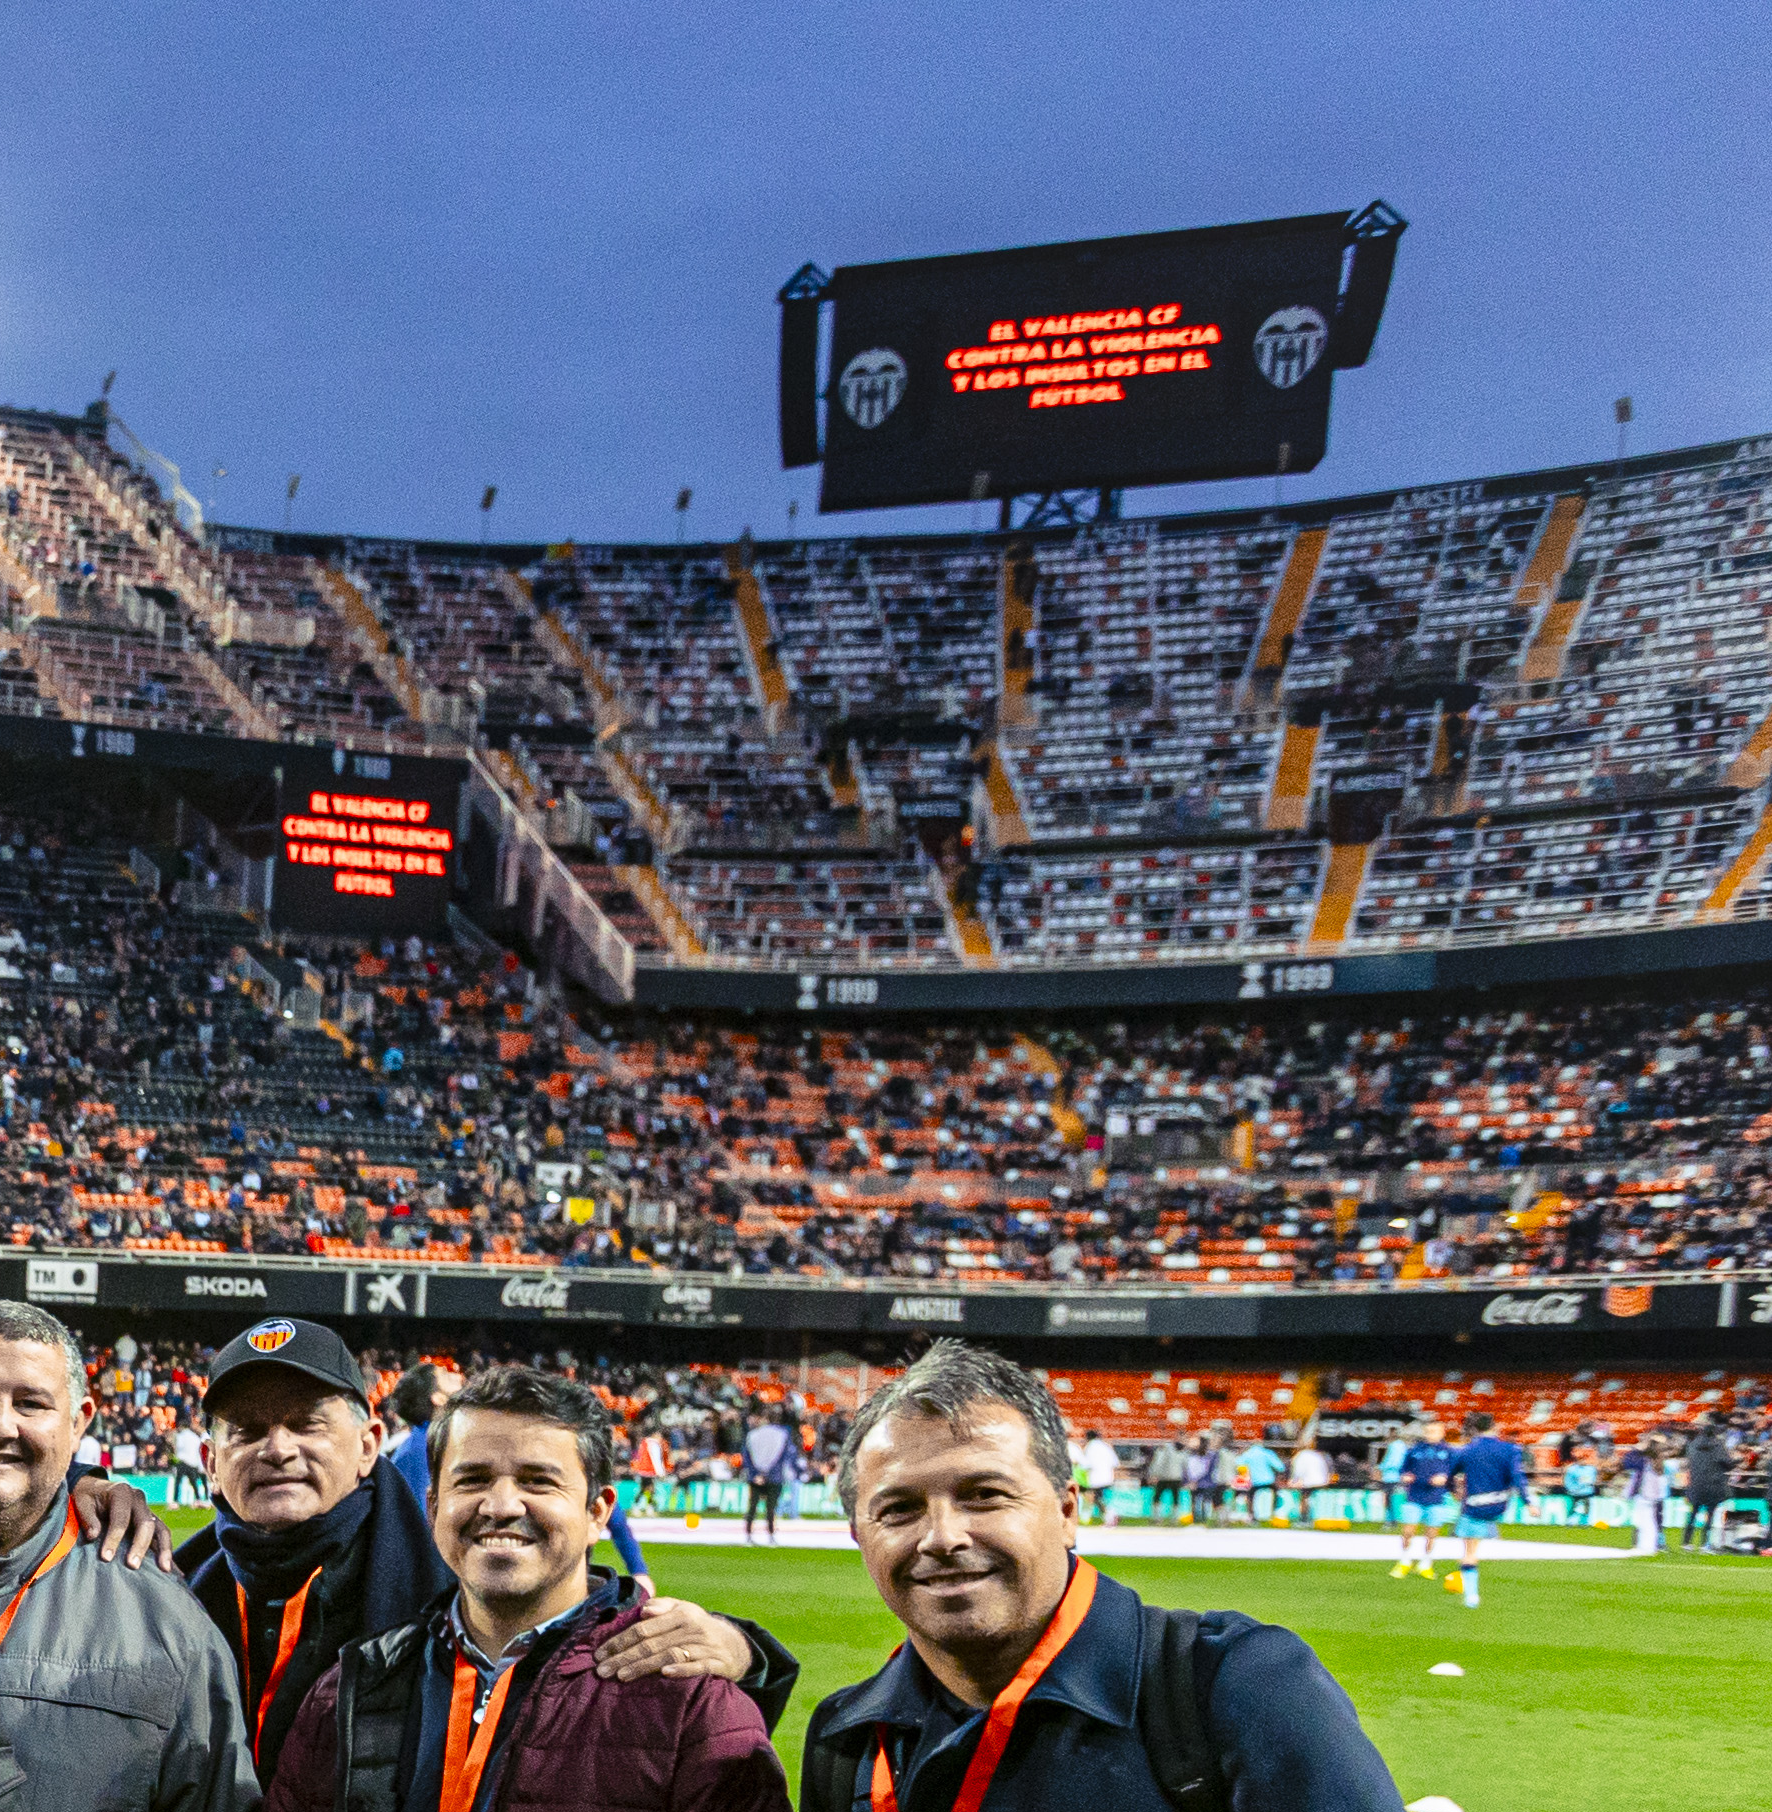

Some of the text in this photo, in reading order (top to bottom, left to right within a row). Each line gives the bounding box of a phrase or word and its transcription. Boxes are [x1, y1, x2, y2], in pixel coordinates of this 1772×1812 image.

[988, 302, 1182, 342] EL VALENCIA CF
[945, 323, 1222, 370] CONTRA LA VIOLENCIA
[951, 348, 1212, 393] Y LOS INSULTOS EN EL
[34, 1269, 56, 1284] TM
[1481, 1292, 1587, 1326] Coca-Cola
